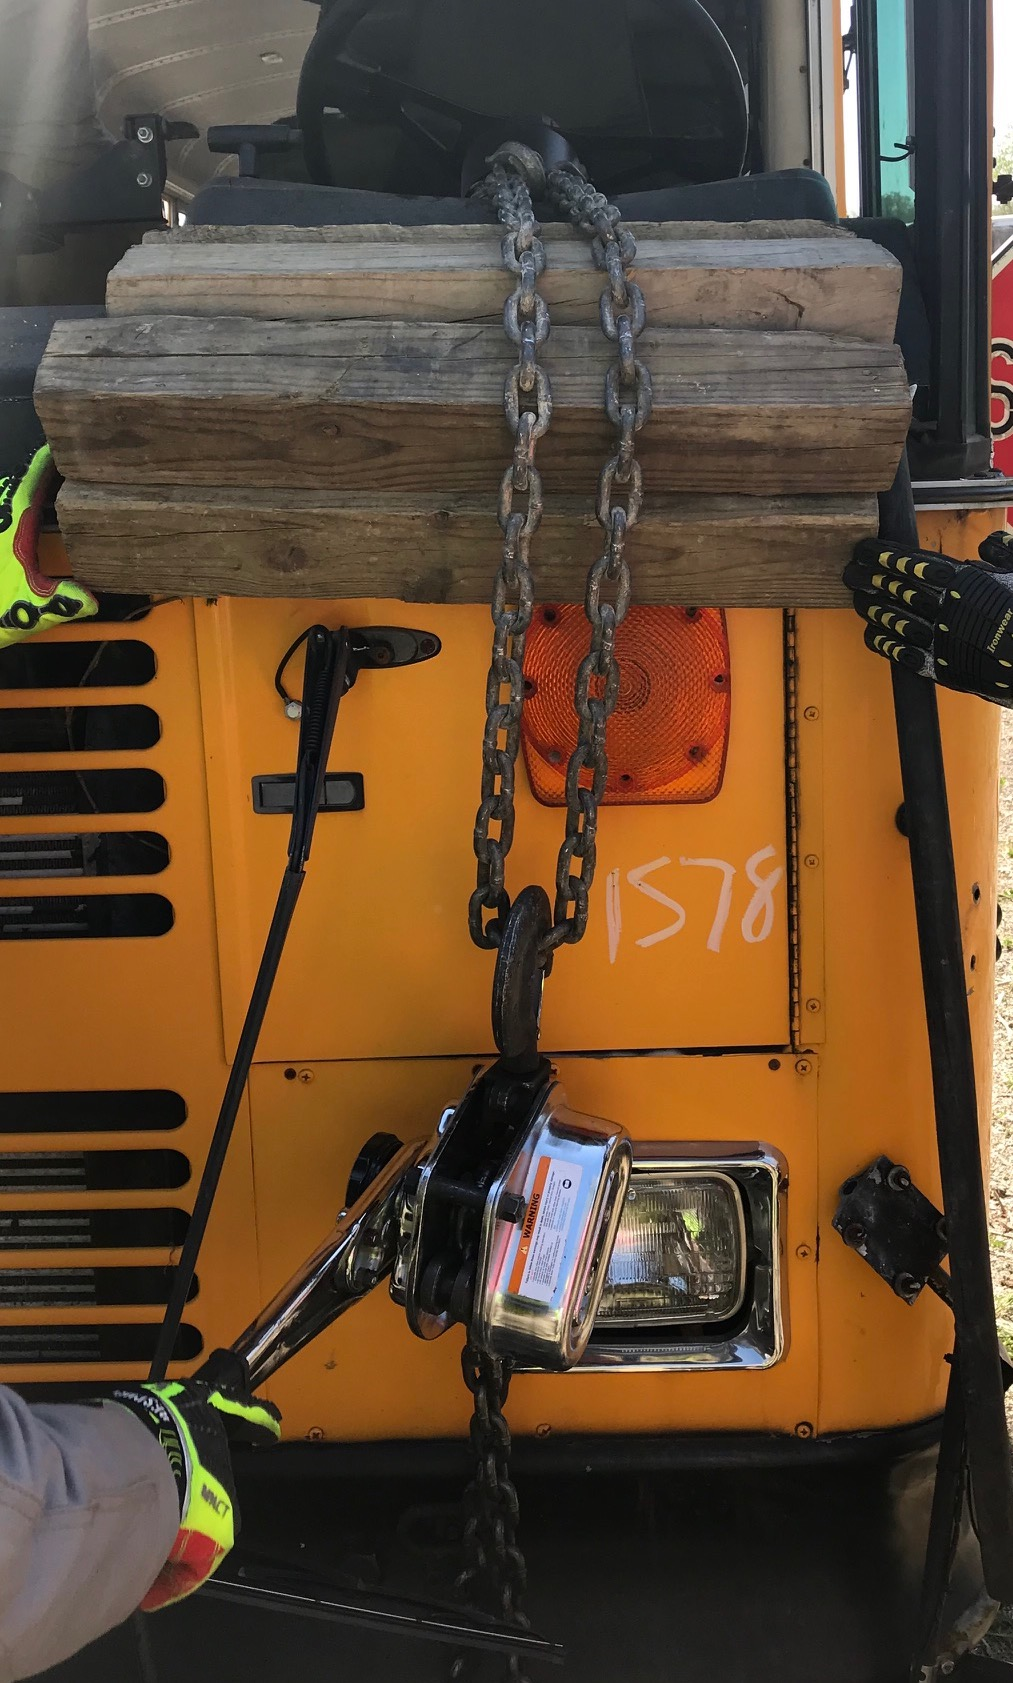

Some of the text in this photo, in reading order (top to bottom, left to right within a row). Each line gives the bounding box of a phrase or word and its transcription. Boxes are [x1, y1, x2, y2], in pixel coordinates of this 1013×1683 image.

[986, 607, 1013, 654] Ironwear
[606, 844, 783, 964] 1578
[523, 1193, 541, 1239] WARNING
